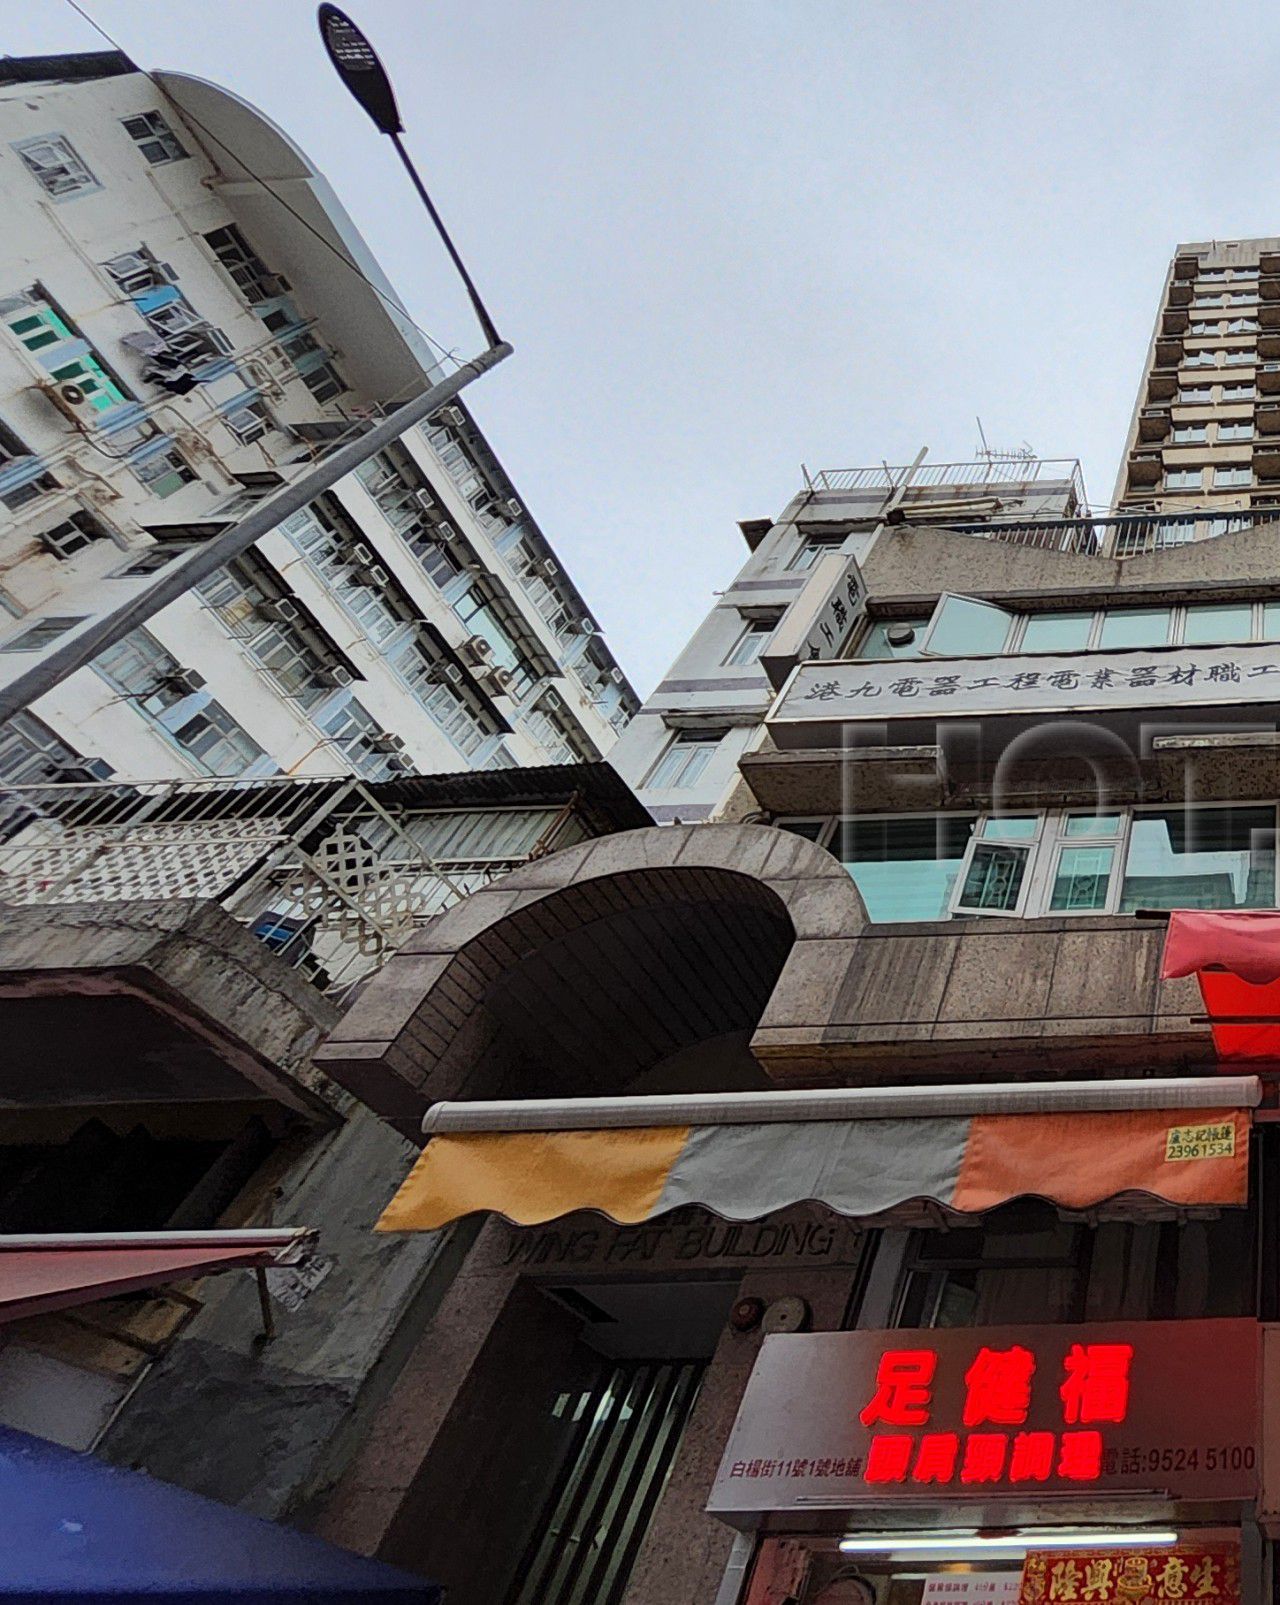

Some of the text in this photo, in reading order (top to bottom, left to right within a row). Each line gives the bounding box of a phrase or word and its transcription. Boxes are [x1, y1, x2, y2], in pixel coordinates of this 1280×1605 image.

[1167, 1142, 1232, 1159] 23961534
[500, 1222, 836, 1266] WING FAT BUILDING
[859, 1343, 1135, 1427] 足健福
